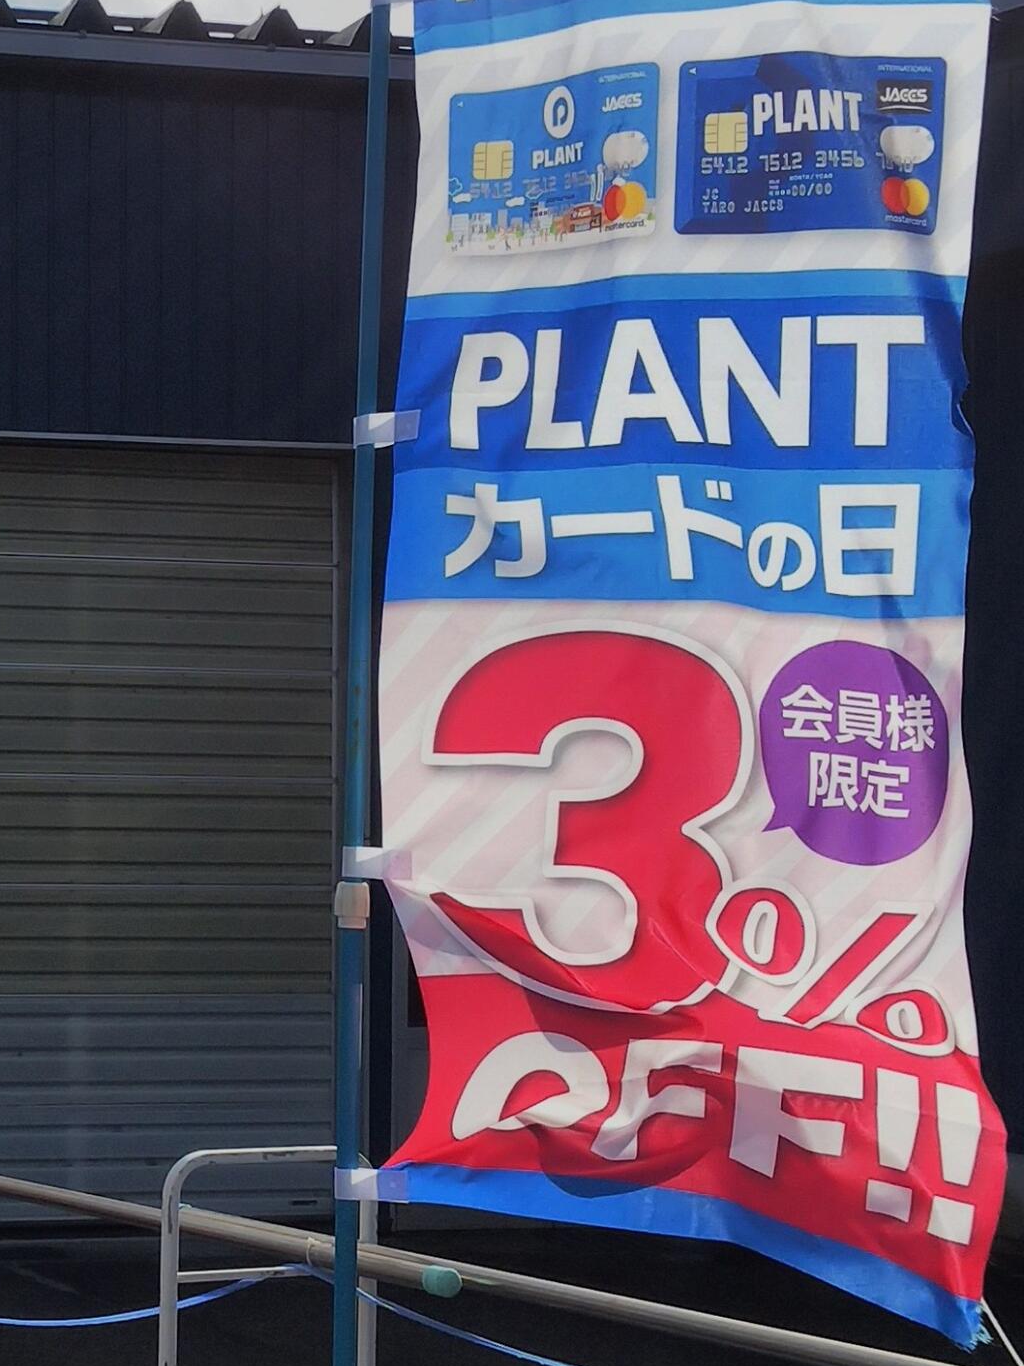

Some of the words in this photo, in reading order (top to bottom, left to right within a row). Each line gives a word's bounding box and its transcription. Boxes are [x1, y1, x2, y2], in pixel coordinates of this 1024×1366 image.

[602, 92, 643, 112] JACCS
[752, 88, 863, 136] PLANT
[878, 86, 929, 103] JACCS
[532, 141, 585, 170] PLANT
[700, 155, 749, 175] 5412
[759, 151, 803, 173] 7512
[815, 150, 865, 169] 3456
[449, 315, 926, 451] PLANT
[444, 474, 921, 597] カードの日
[780, 684, 936, 753] 会員様
[807, 752, 911, 819] 限定
[423, 622, 955, 1053] 3%
[451, 1030, 983, 1246] OFF!!
